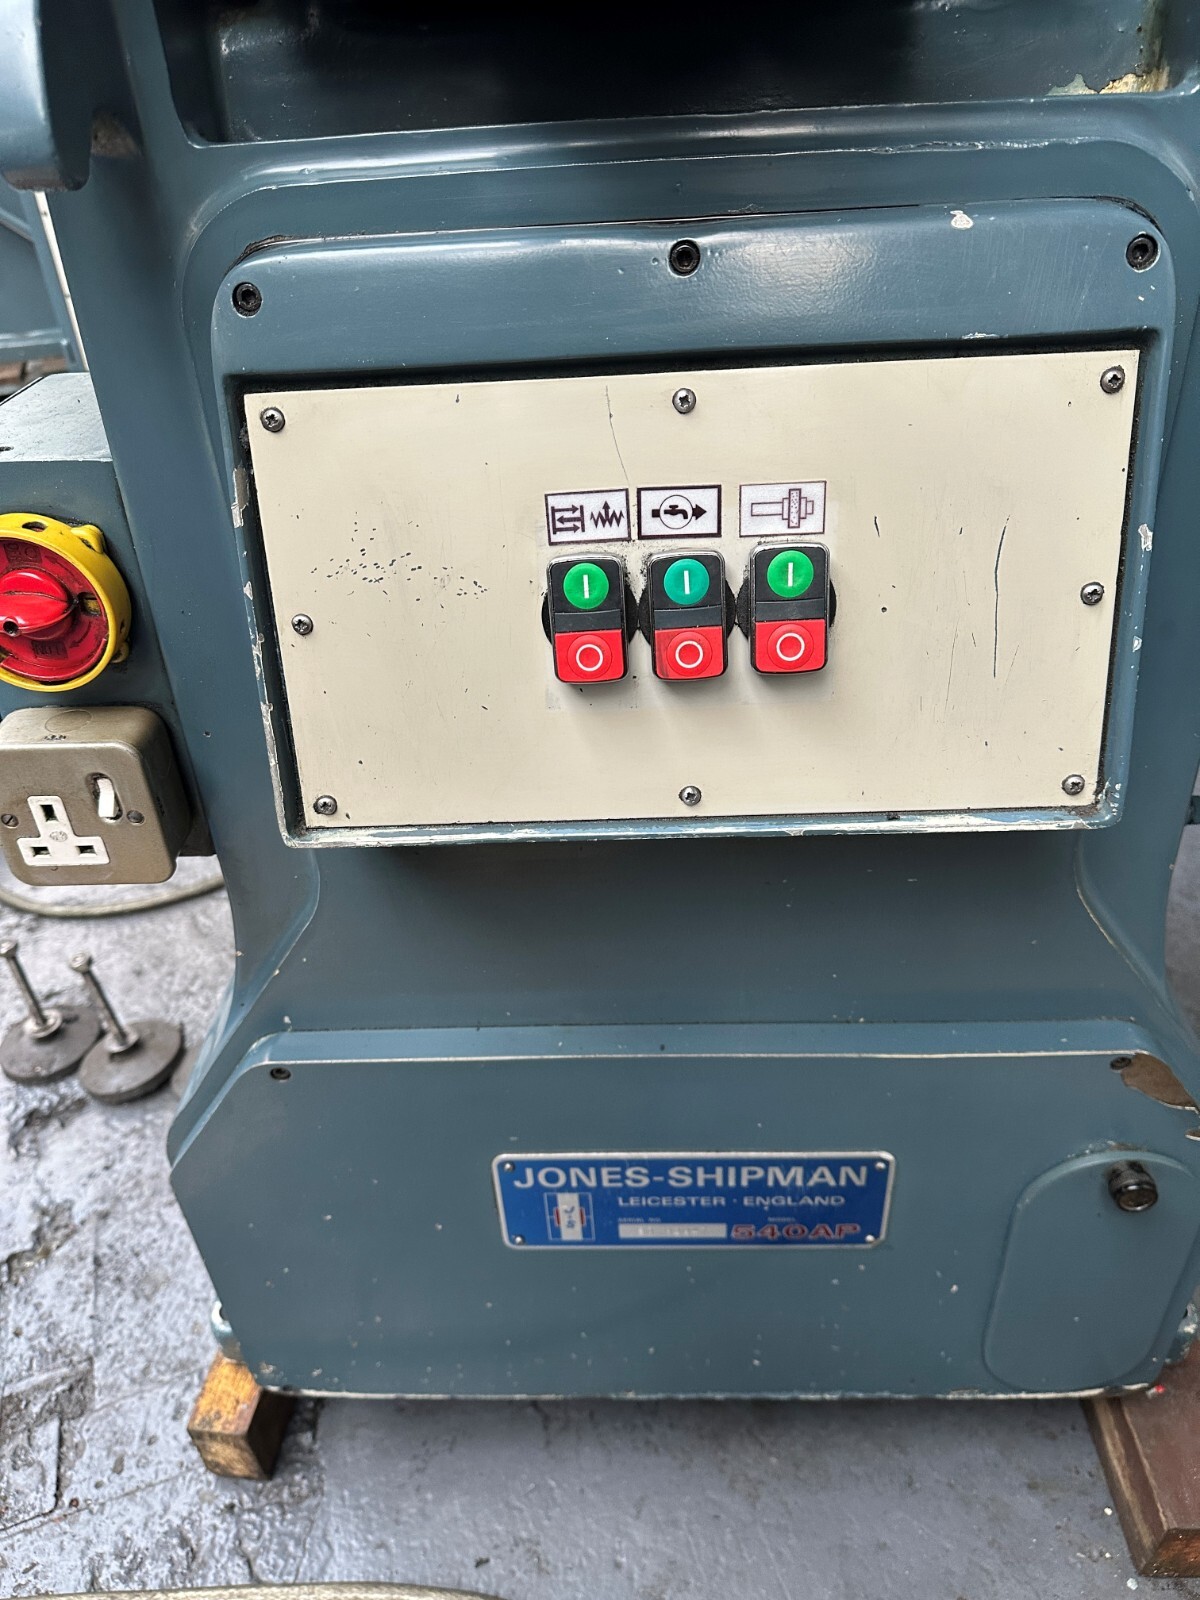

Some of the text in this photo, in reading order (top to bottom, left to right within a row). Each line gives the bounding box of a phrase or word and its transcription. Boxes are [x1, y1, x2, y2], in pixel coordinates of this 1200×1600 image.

[513, 1165, 867, 1189] JONES-SHIPMAN
[618, 1195, 846, 1207] LEICESTER ENGLAND
[730, 1223, 860, 1240] 540AP
